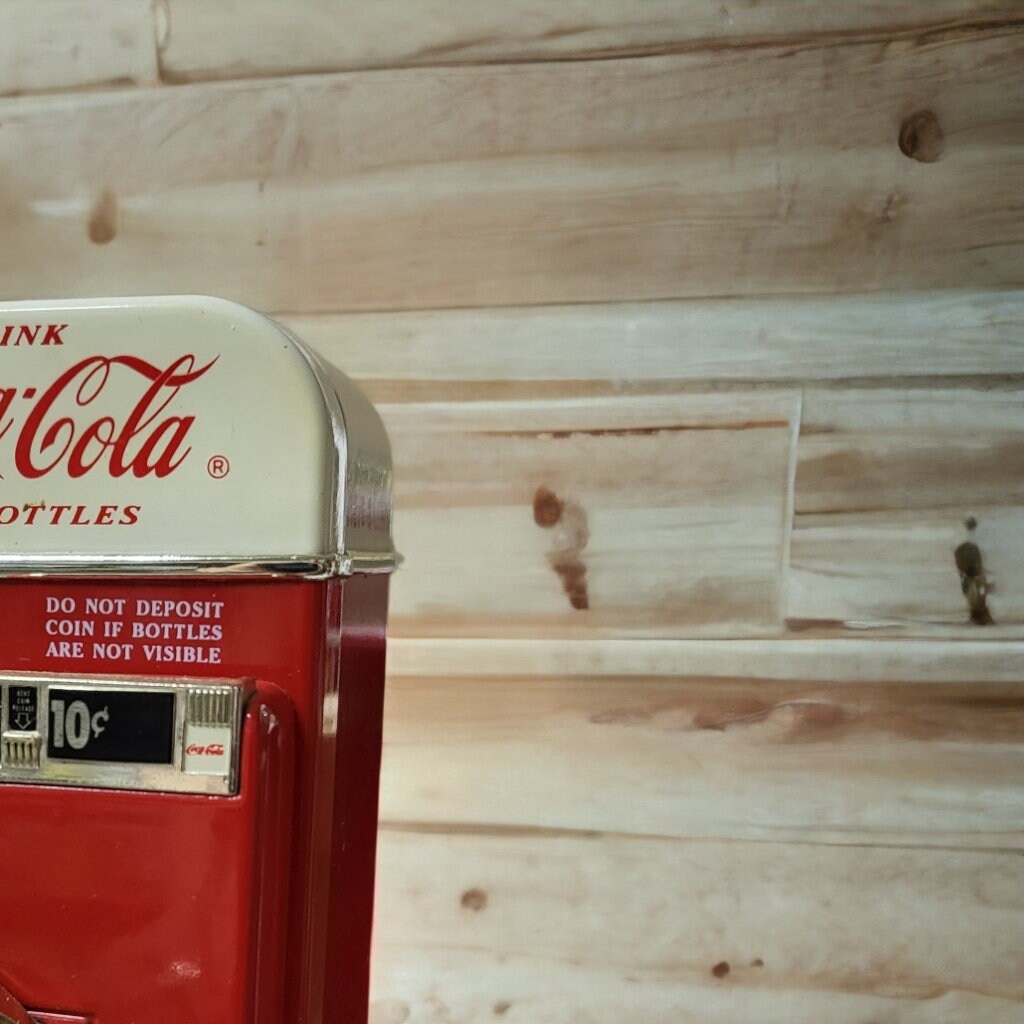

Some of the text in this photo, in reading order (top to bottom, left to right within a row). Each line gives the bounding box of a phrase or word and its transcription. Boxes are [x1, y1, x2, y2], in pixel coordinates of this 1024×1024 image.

[46, 597, 224, 619] DO NOT DEPOSIT
[45, 619, 223, 641] COIN IF BOTTLES
[46, 642, 221, 664] ARE NOT VISIBLE
[50, 699, 110, 750] 10¢
